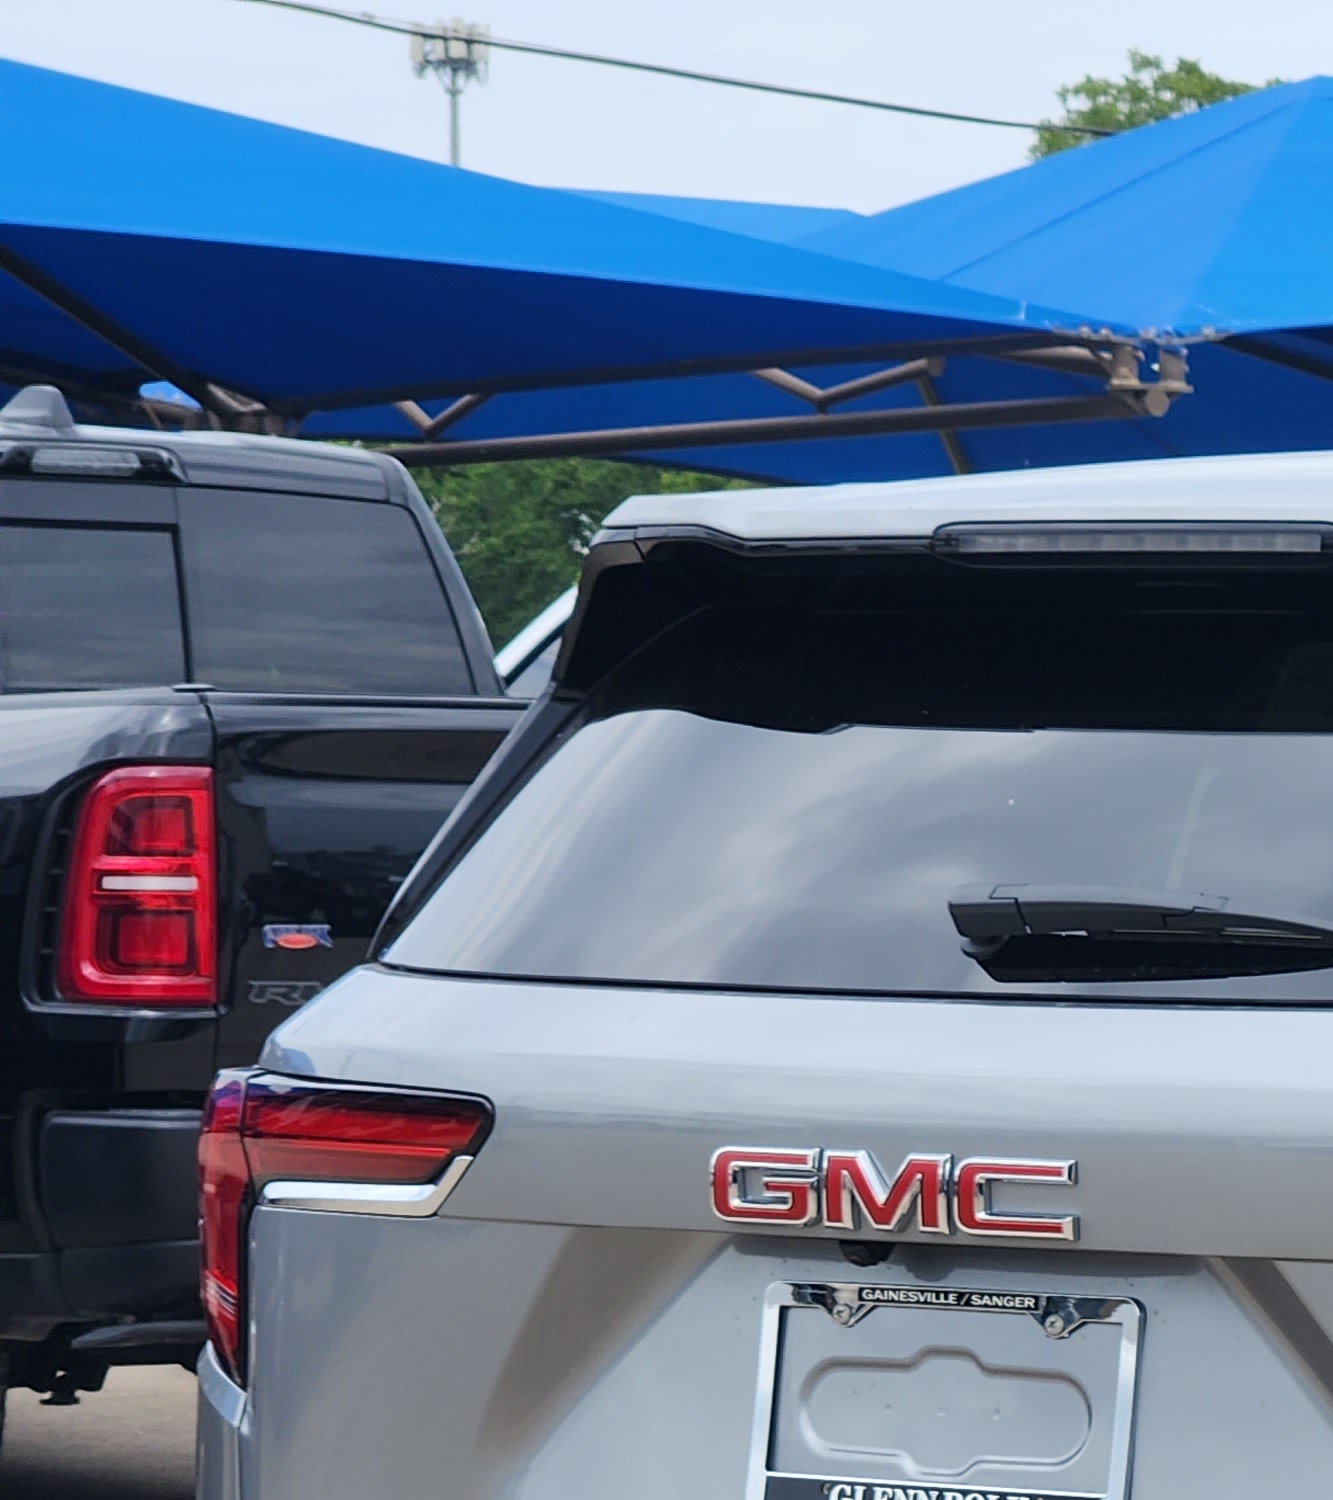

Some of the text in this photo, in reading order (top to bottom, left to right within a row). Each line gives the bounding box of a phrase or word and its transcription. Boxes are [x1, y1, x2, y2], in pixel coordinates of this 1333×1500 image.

[709, 1146, 1080, 1242] GMC
[861, 1289, 959, 1305] GAINESVILLE
[970, 1294, 1036, 1309] SANGER
